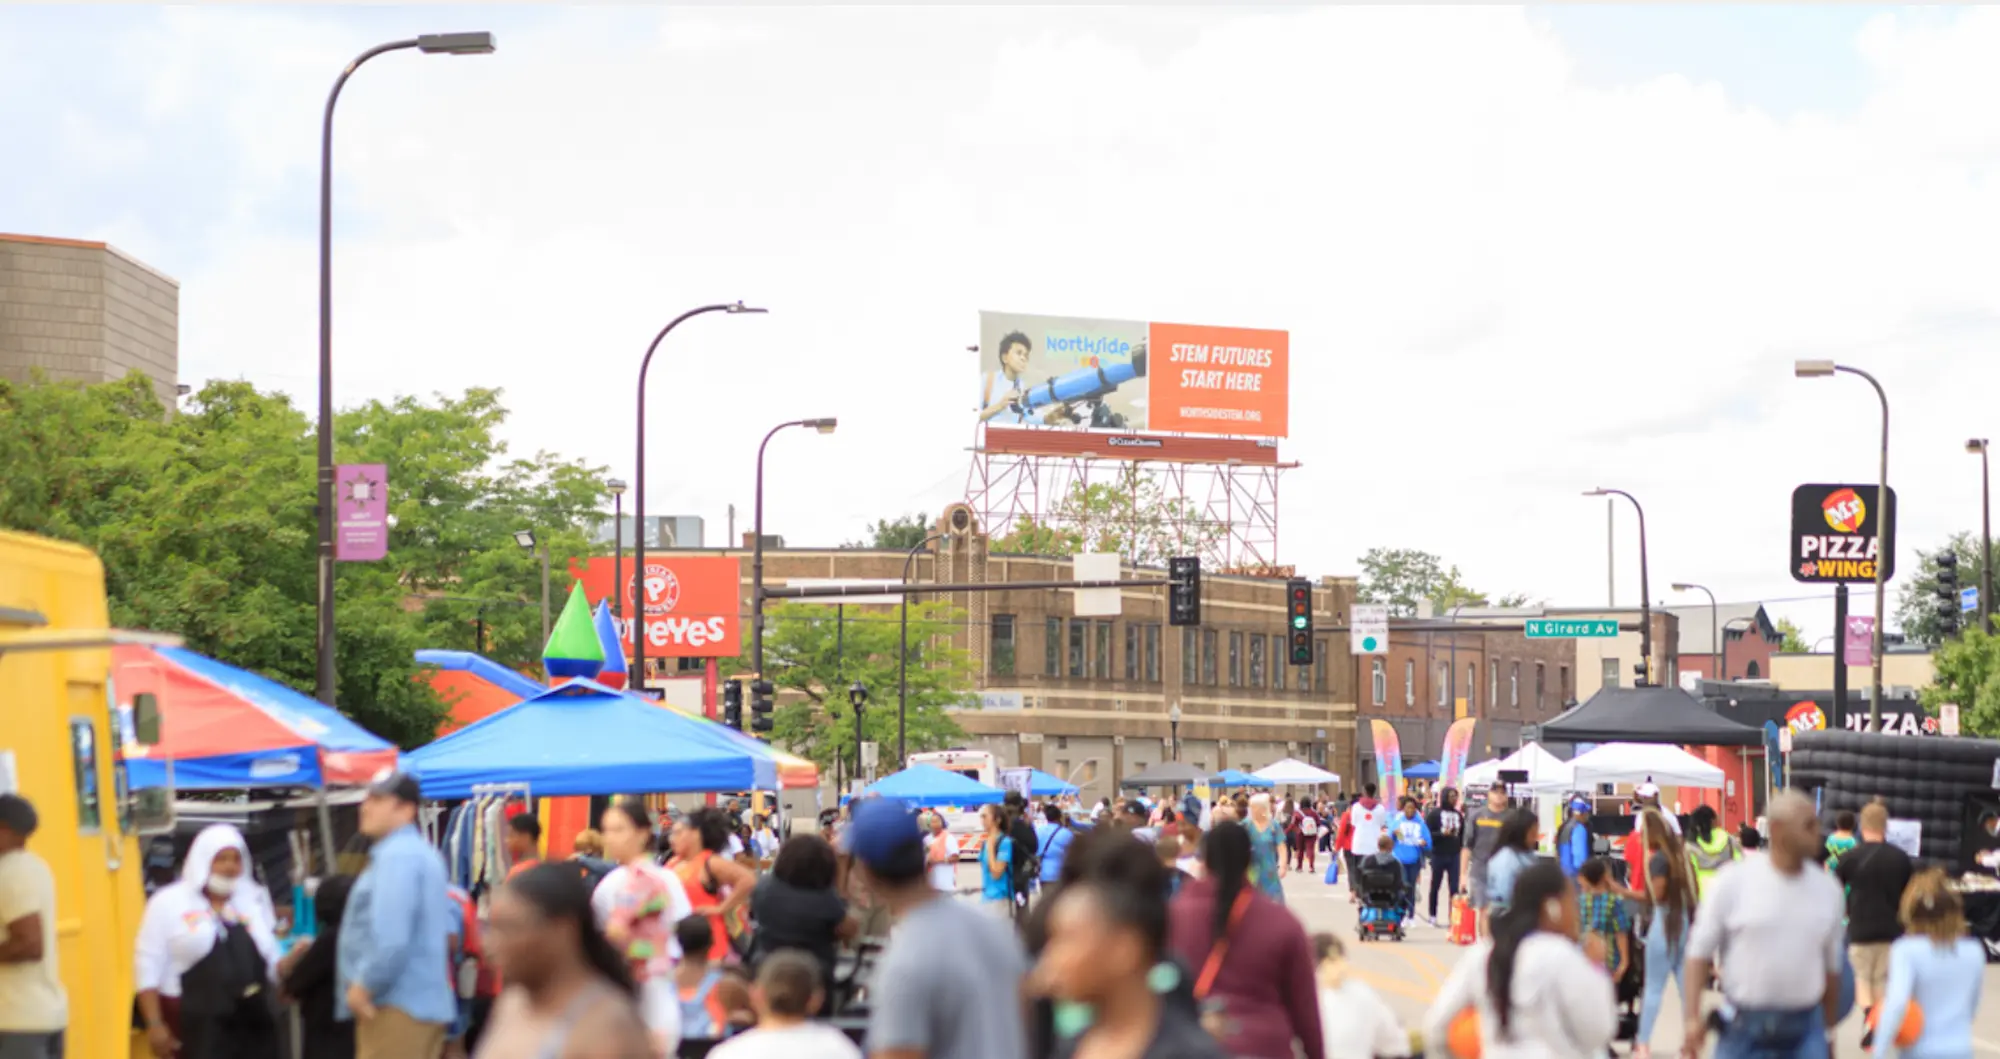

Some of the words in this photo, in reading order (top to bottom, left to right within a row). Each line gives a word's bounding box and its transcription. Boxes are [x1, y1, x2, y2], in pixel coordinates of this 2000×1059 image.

[1046, 335, 1129, 356] Northside
[1170, 343, 1208, 363] STEM
[1211, 345, 1272, 367] FUTURES
[1181, 369, 1224, 389] START
[1225, 371, 1261, 391] HERE
[1826, 500, 1860, 525] Mr
[1817, 560, 1878, 578] WING
[1529, 623, 1539, 634] N
[1544, 622, 1588, 635] Girard
[1595, 623, 1615, 634] Av
